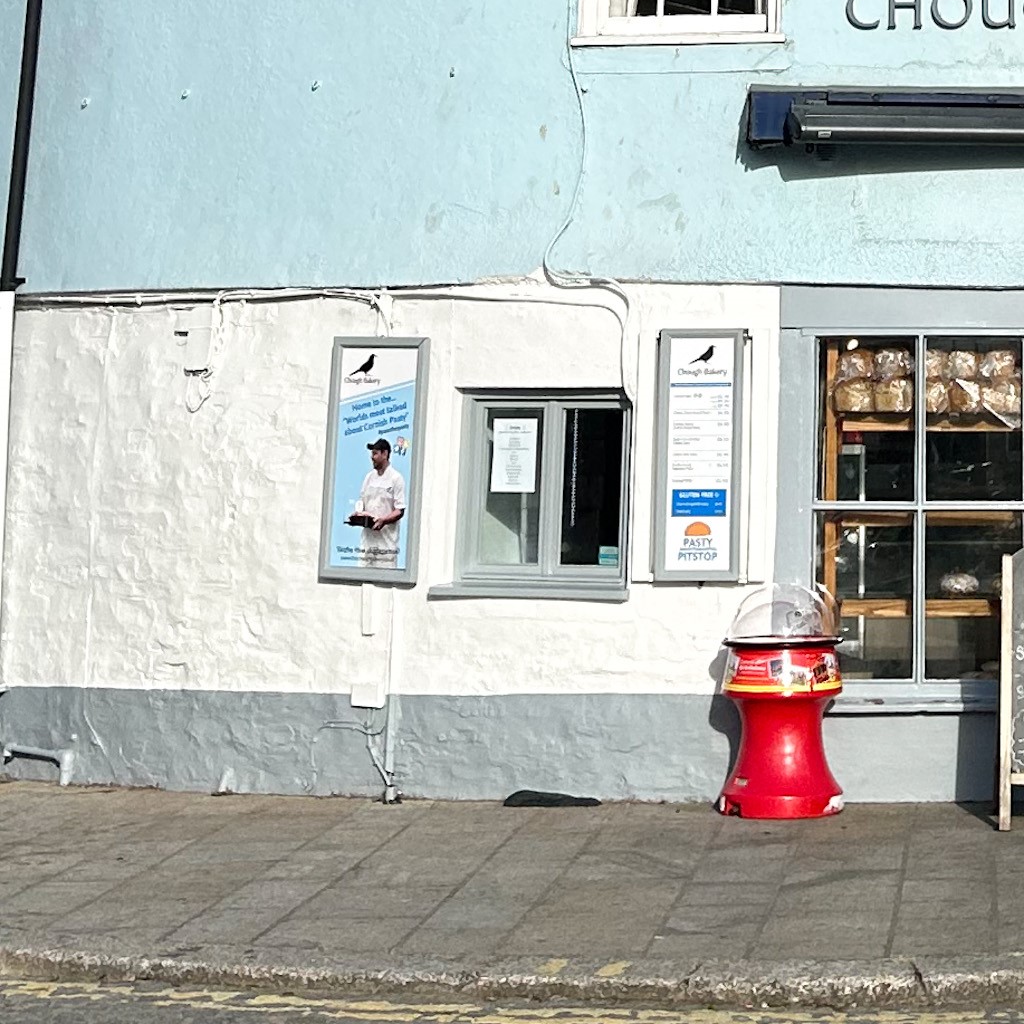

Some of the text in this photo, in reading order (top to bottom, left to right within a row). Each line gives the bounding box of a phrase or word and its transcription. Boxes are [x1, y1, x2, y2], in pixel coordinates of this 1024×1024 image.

[352, 401, 372, 412] Home
[369, 408, 386, 418] most
[344, 425, 364, 437] about
[363, 418, 388, 432] Cornish
[683, 537, 713, 548] PASTY
[678, 551, 718, 562] PITSTOP
